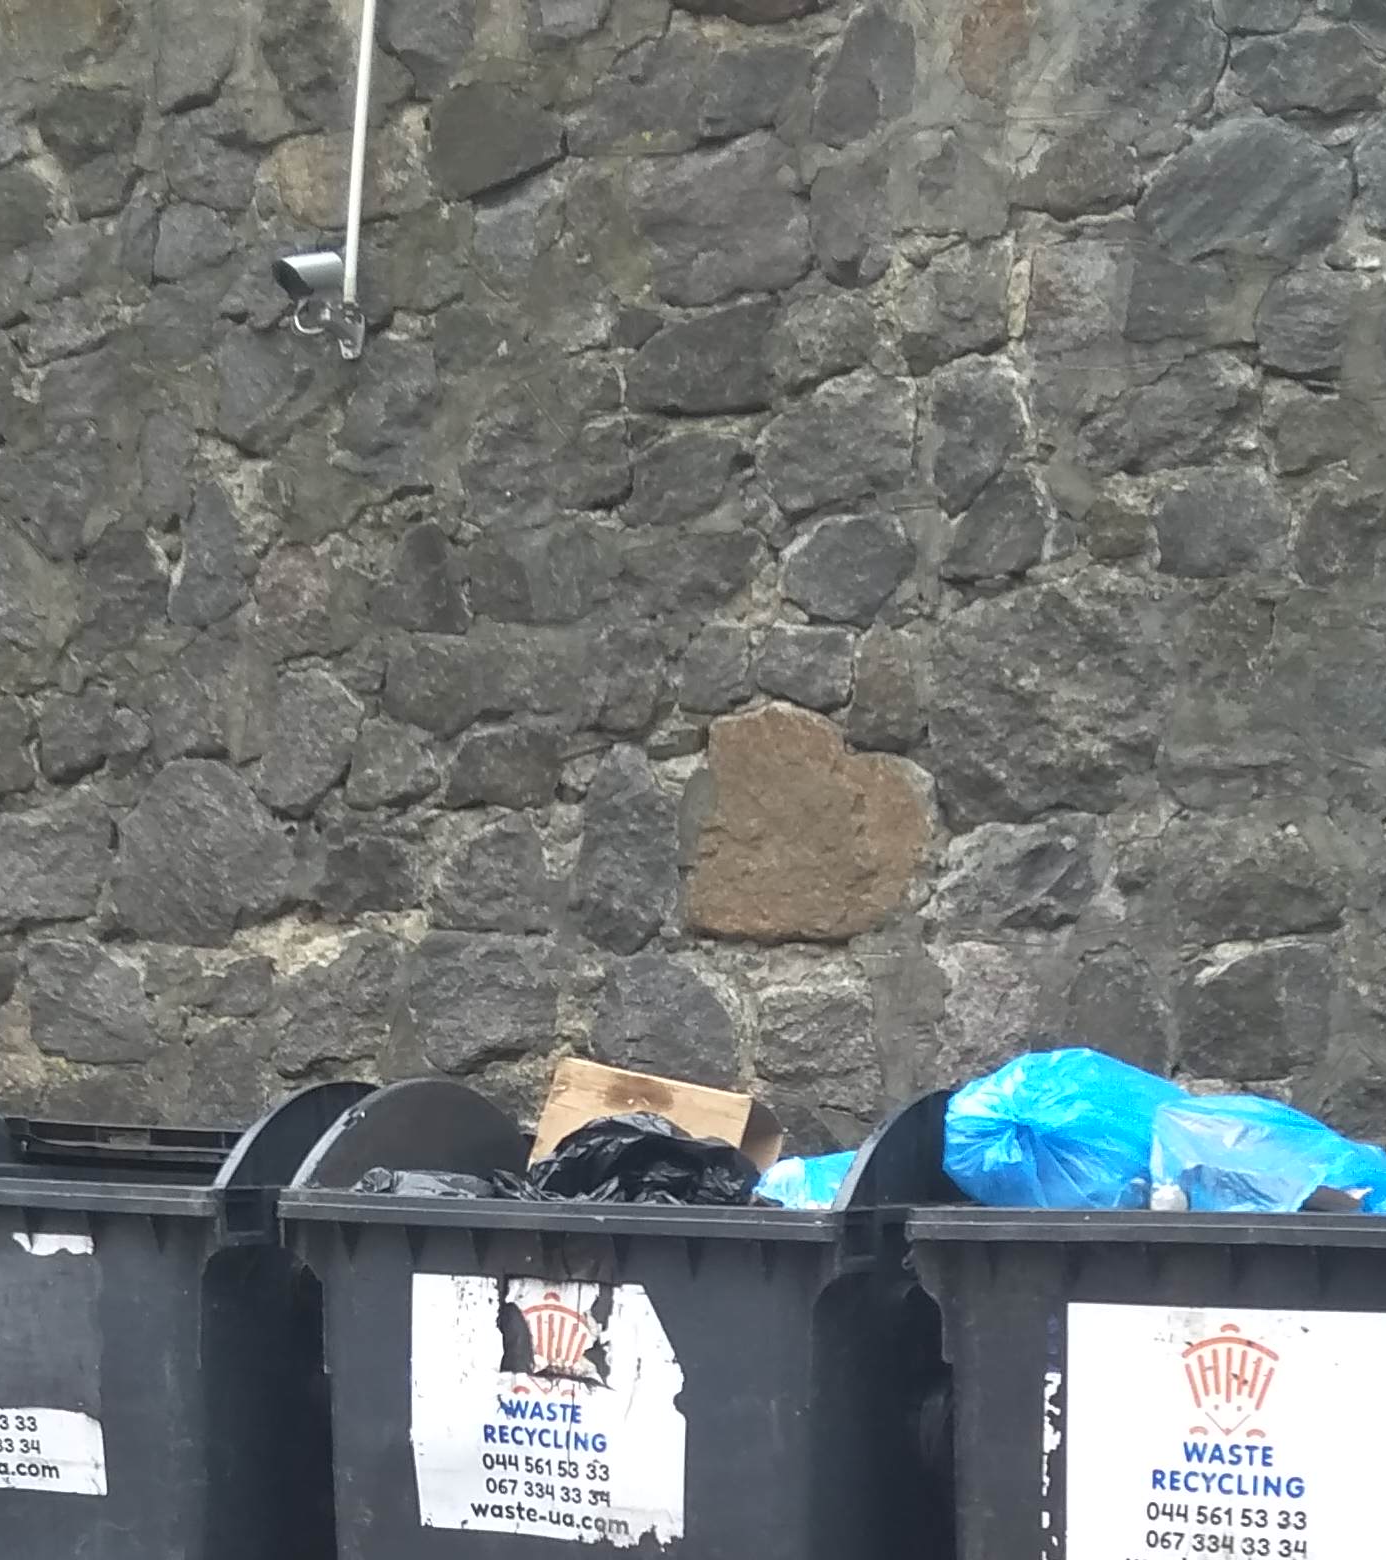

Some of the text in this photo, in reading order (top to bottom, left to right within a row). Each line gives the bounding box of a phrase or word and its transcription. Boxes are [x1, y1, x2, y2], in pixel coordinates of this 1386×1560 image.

[14, 1414, 38, 1432] 33
[504, 1399, 582, 1424] WASTE
[19, 1438, 42, 1454] 34
[483, 1424, 607, 1453] RECYCLING
[482, 1453, 611, 1482] 044 561 53 33
[1183, 1441, 1274, 1467] WASTE
[485, 1477, 518, 1495] 067
[524, 1481, 555, 1501] 334
[560, 1486, 582, 1504] 33
[1151, 1469, 1306, 1499] RECYCLING
[470, 1501, 630, 1536] waste-ua.com
[1146, 1501, 1308, 1531] 044 561 53 33
[1145, 1529, 1308, 1559] 067 334 33 34
